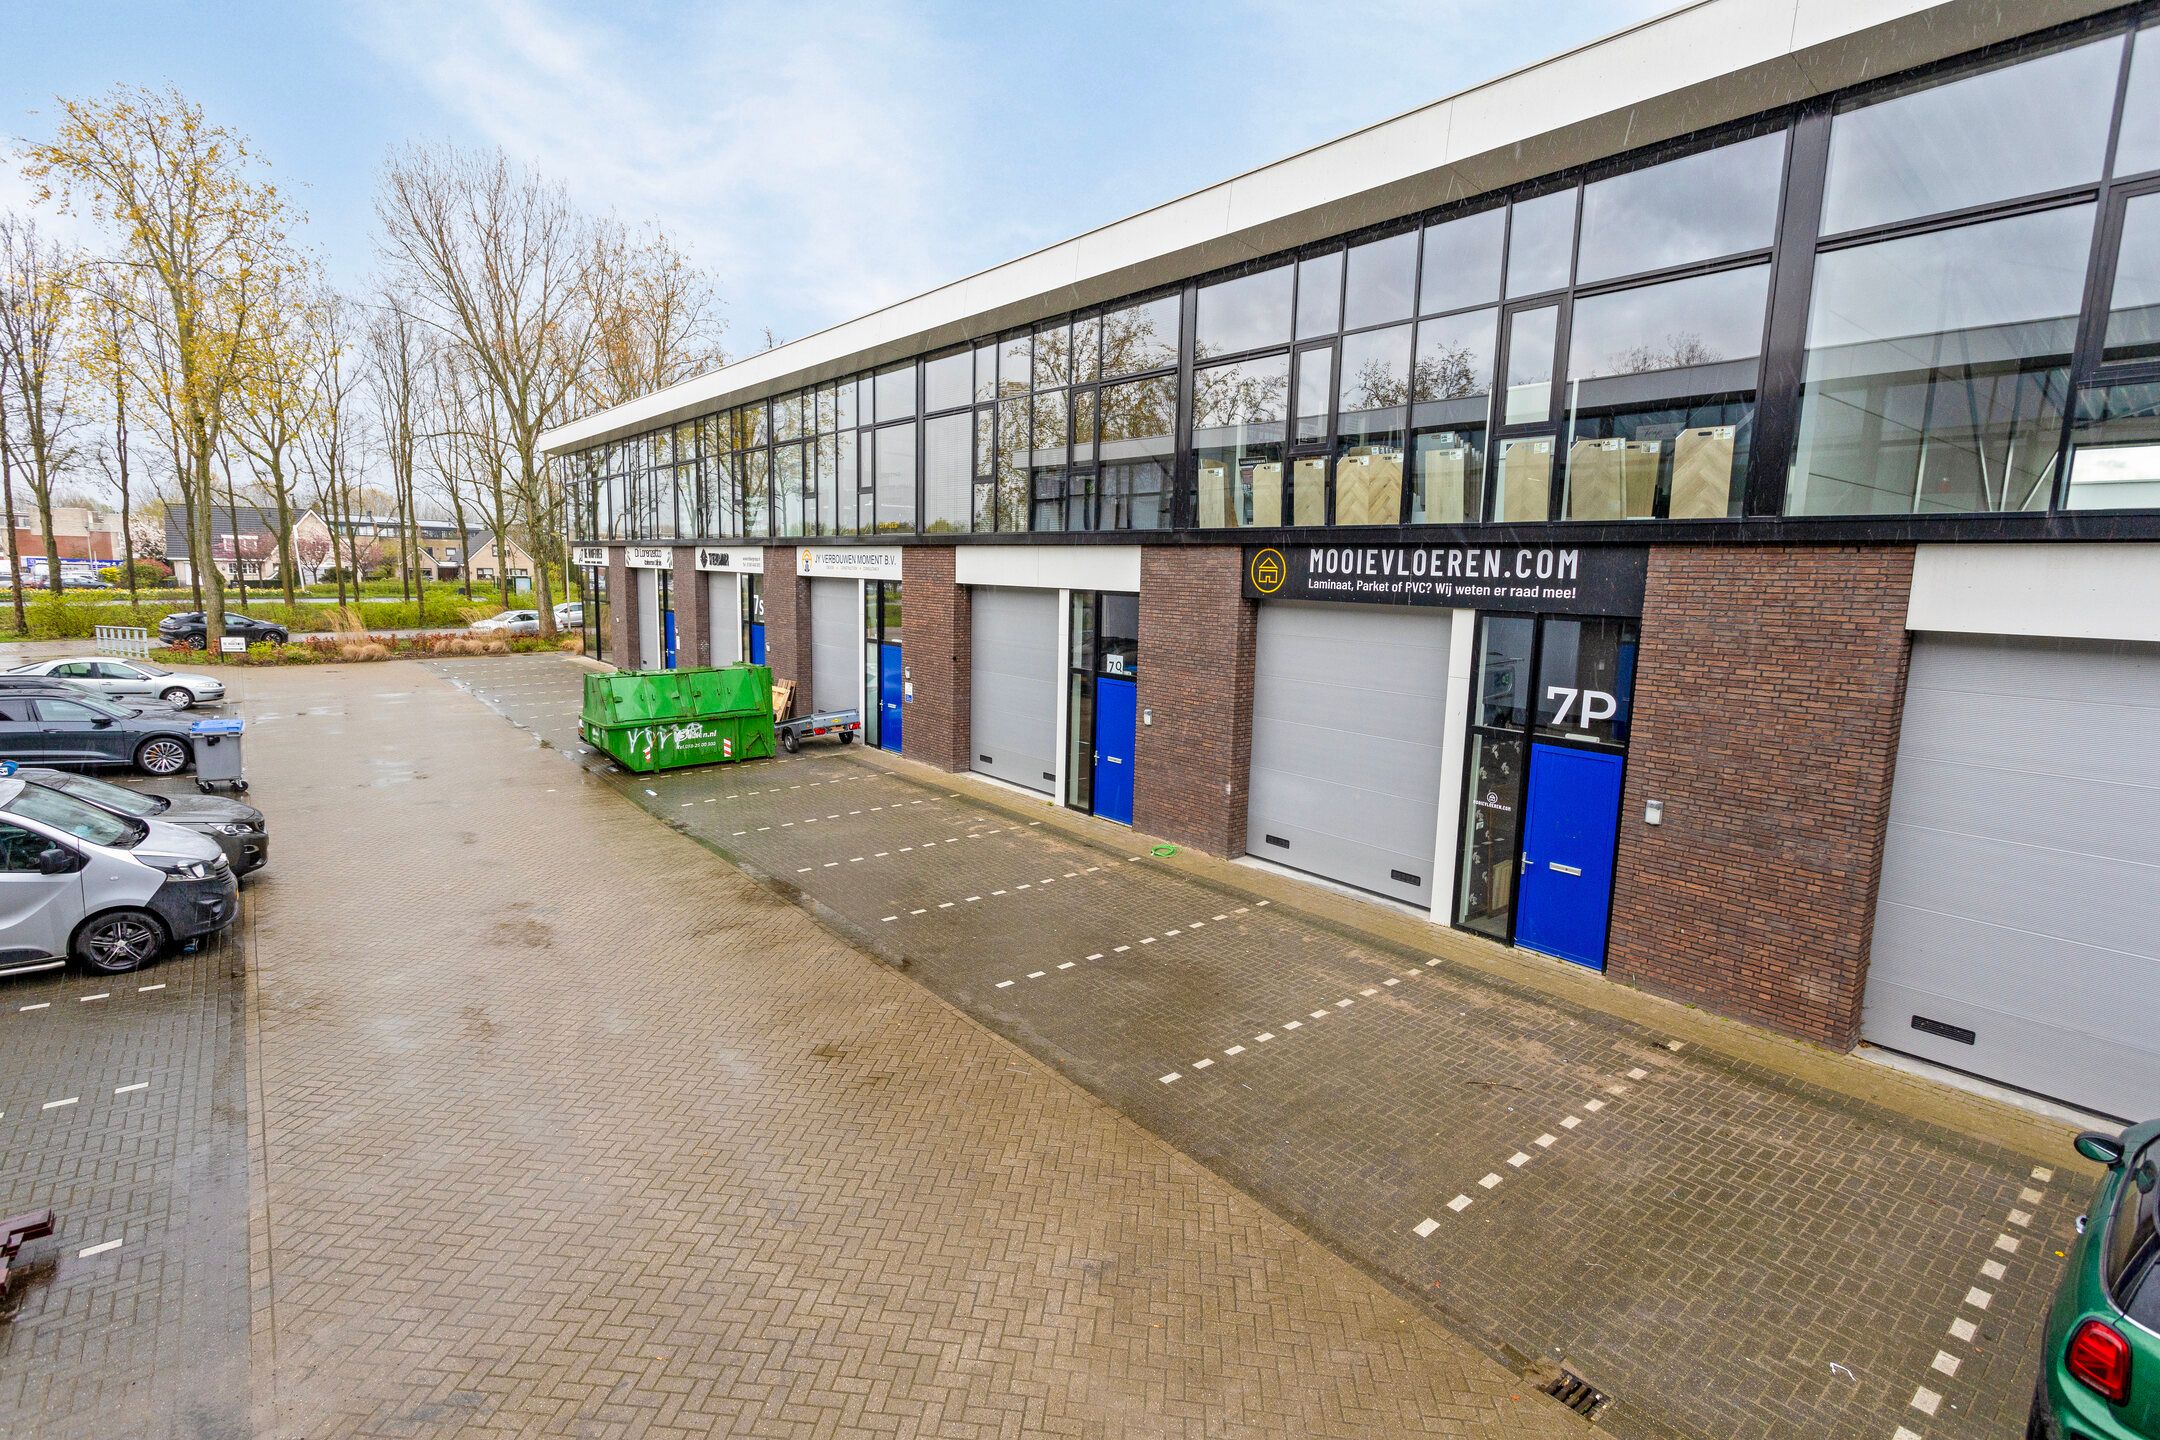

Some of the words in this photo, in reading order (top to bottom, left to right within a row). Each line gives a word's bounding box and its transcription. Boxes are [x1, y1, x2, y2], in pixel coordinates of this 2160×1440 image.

[822, 554, 856, 565] VERBOUWEN
[857, 554, 883, 565] MOMENT
[884, 555, 897, 566] B.V.
[1309, 548, 1579, 579] MOOIEVLOEREN.COM
[1308, 578, 1354, 591] Laminaat,
[1356, 580, 1390, 592] Parket
[1391, 581, 1403, 592] of
[1405, 581, 1432, 593] PVC?
[1435, 582, 1453, 597] Wij
[1455, 585, 1491, 596] weten
[1493, 587, 1507, 597] er
[1509, 586, 1539, 598] raad
[1542, 587, 1577, 599] mee!
[753, 594, 764, 616] 7S
[1109, 661, 1122, 673] 7Q
[1547, 686, 1617, 729] 7P
